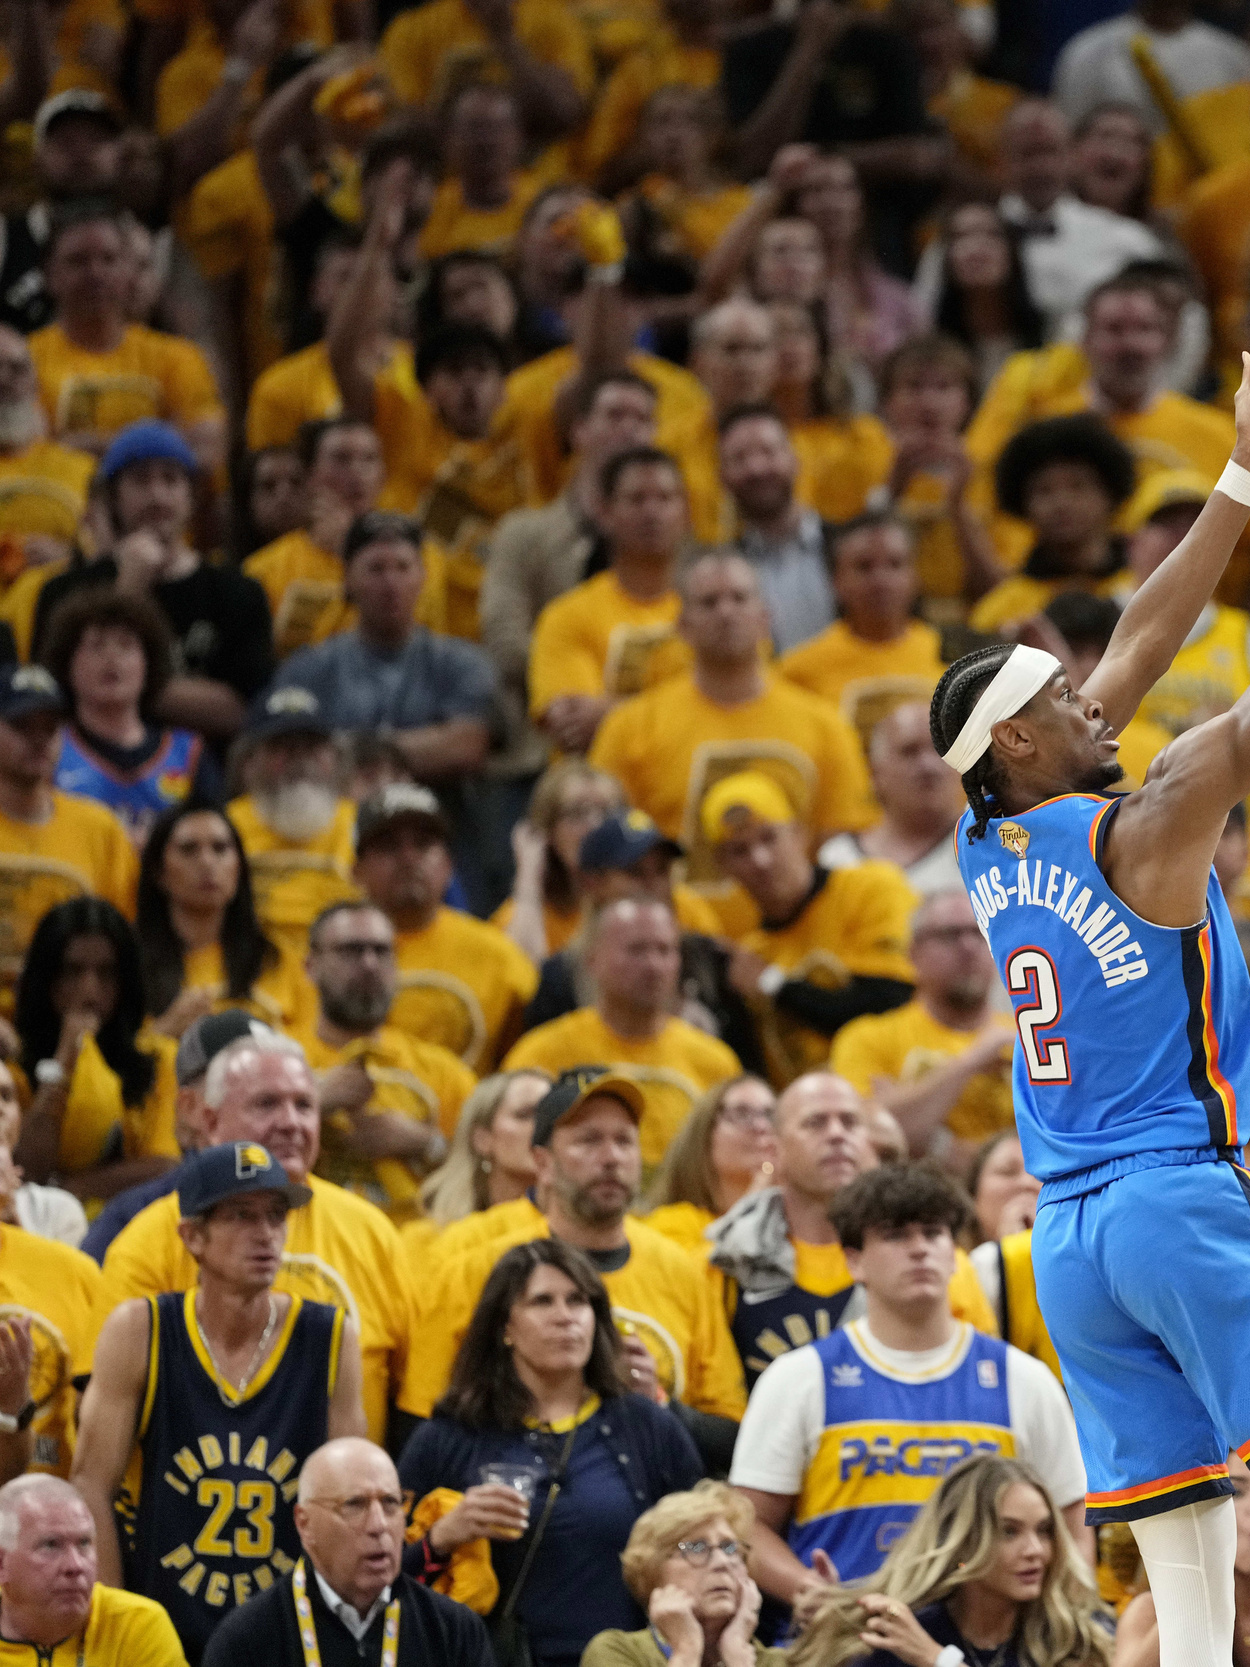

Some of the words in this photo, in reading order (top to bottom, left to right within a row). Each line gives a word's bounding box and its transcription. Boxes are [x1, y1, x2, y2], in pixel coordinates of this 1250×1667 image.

[998, 826, 1029, 847] Finals
[970, 859, 1150, 989] OUS-ALEXANDER
[1005, 945, 1073, 1086] 2
[194, 1478, 276, 1558] 23
